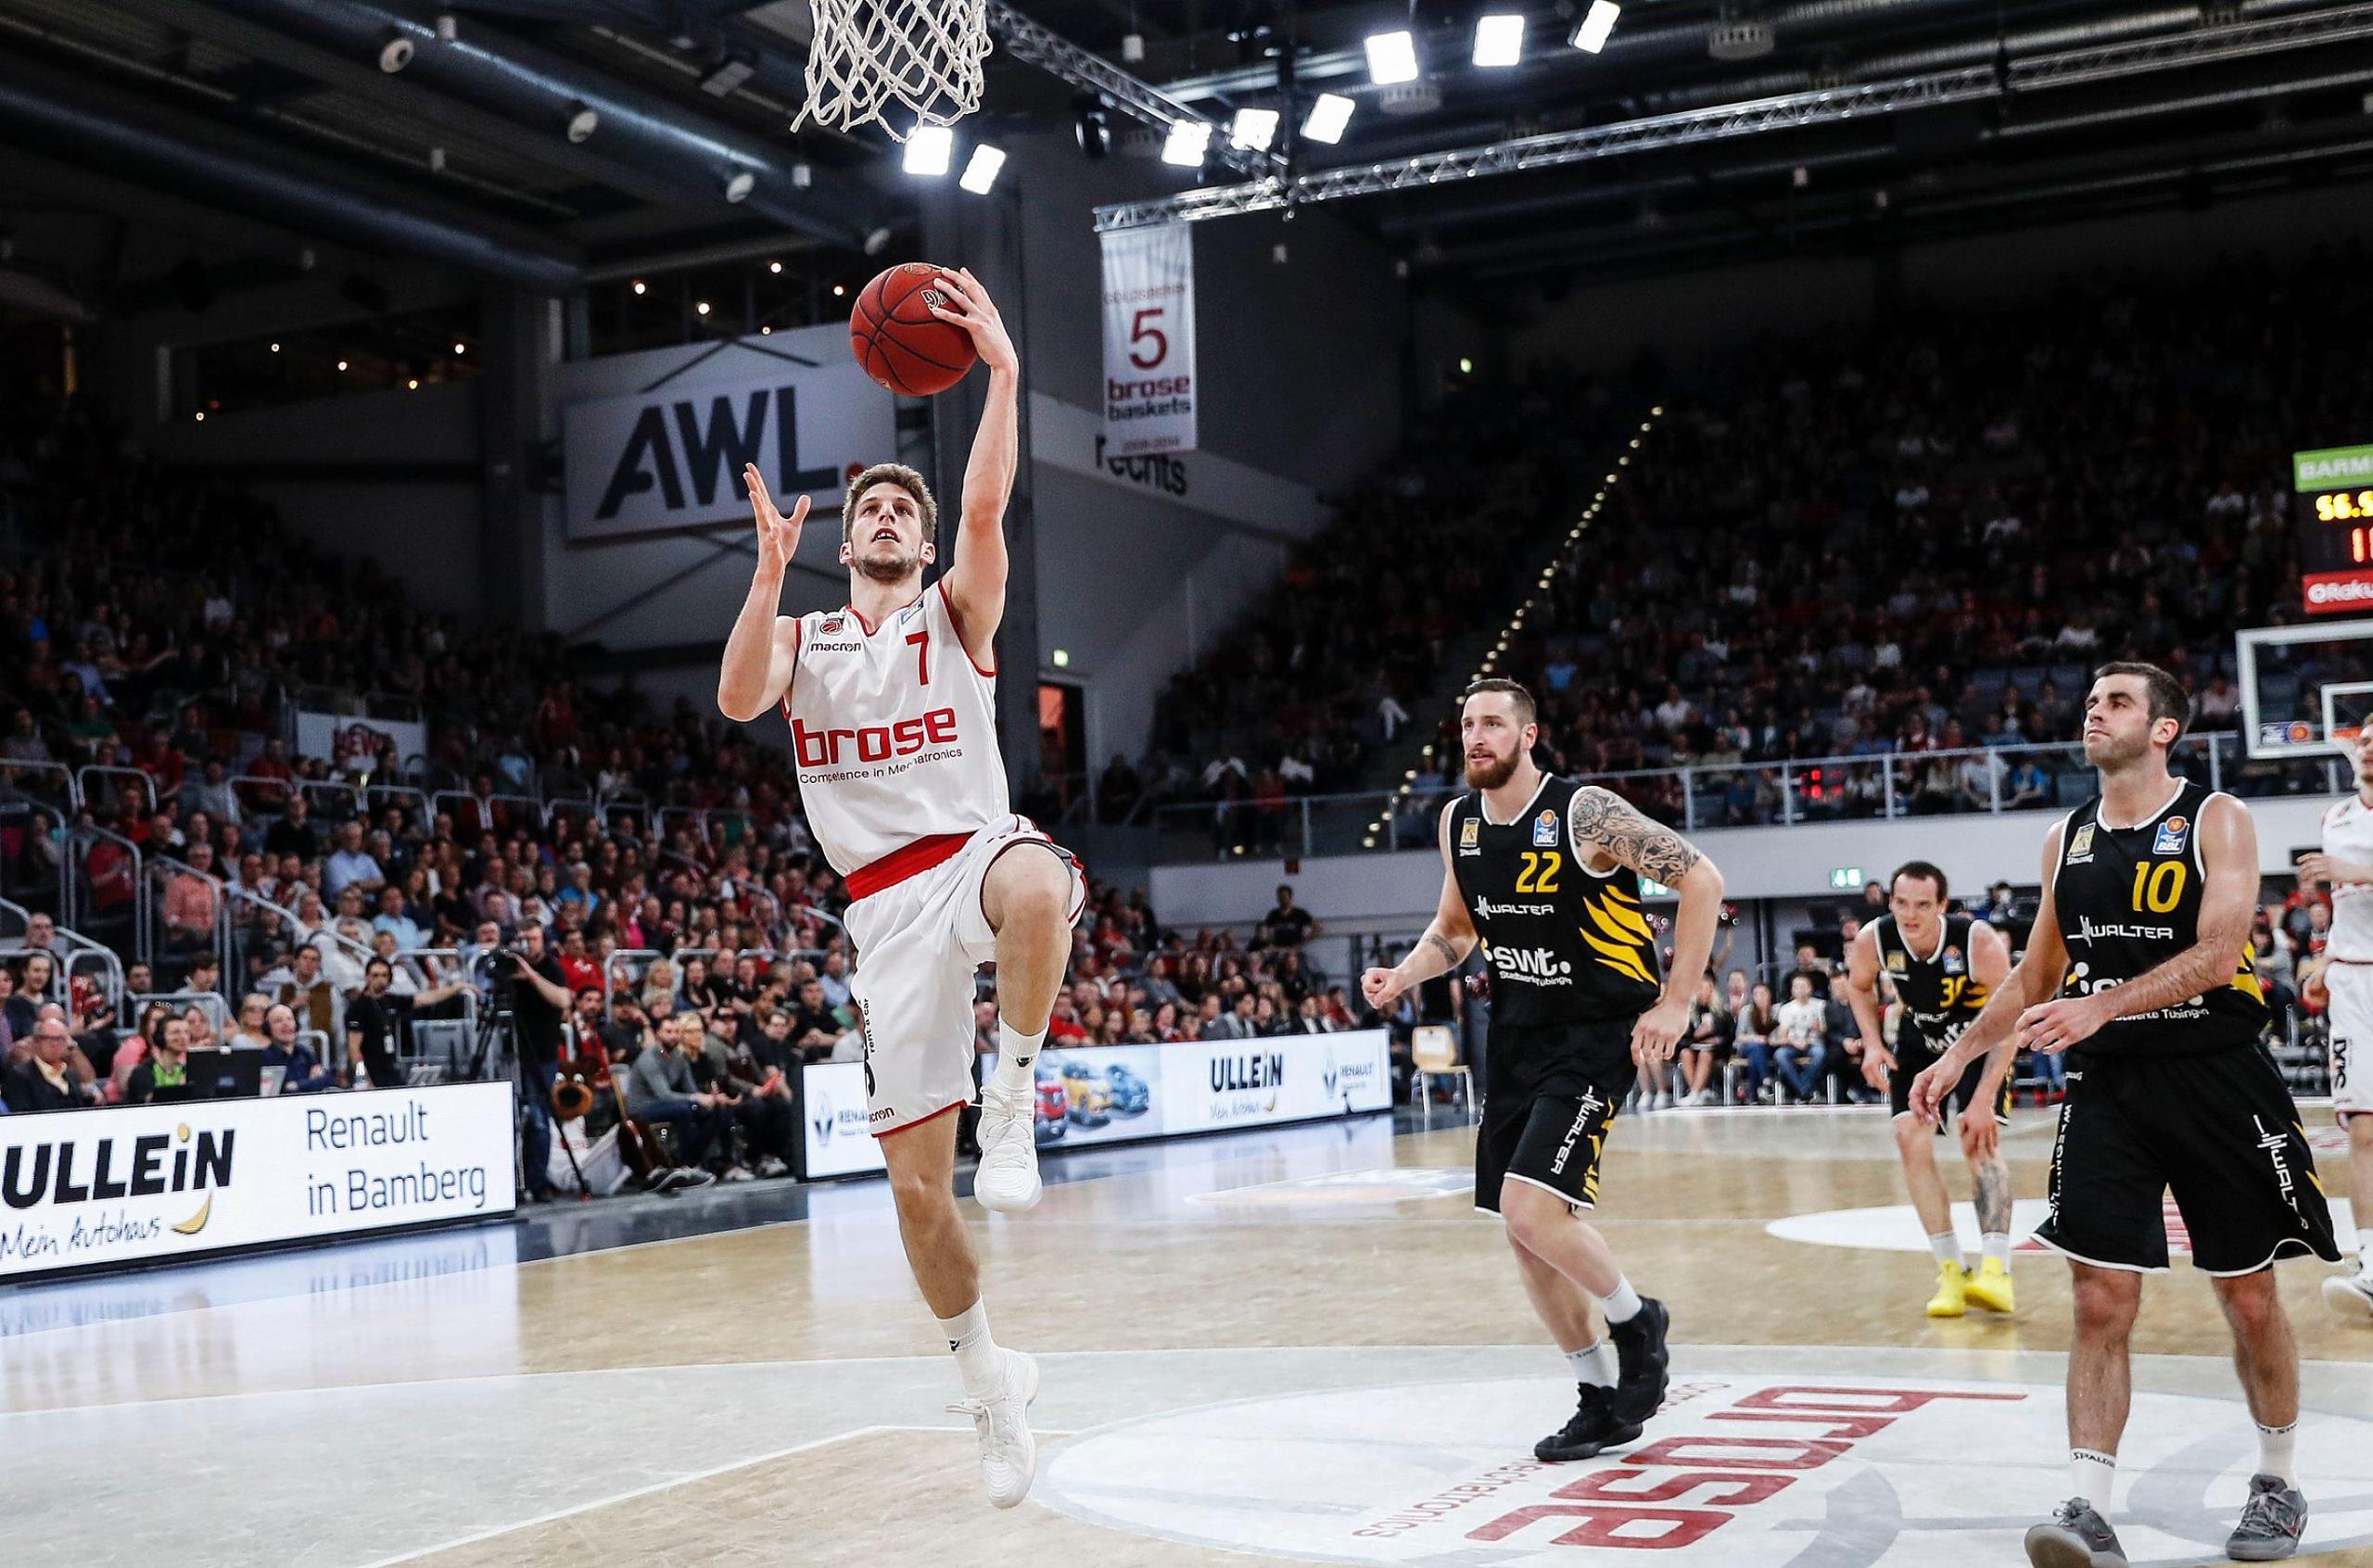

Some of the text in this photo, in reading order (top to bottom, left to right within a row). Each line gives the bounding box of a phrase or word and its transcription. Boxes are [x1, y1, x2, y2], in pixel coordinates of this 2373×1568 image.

[1128, 308, 1168, 370] 5
[1108, 377, 1190, 401] brose
[1109, 397, 1192, 422] baskets
[810, 641, 861, 652] macron
[905, 630, 929, 686] 7
[792, 707, 958, 768] brose
[800, 769, 869, 784] Competence
[873, 767, 884, 778] in
[1516, 851, 1562, 893] 22
[2133, 861, 2188, 914] 10
[1488, 904, 1555, 917] WALTER
[2090, 924, 2174, 940] WALTER
[867, 1029, 876, 1054] rent
[307, 1100, 429, 1151] Renault
[1550, 1102, 1591, 1175] WALTER
[308, 1161, 486, 1216] in Bamberg
[0, 1208, 160, 1261] Mein Autohaus
[1463, 1386, 2029, 1549] brose
